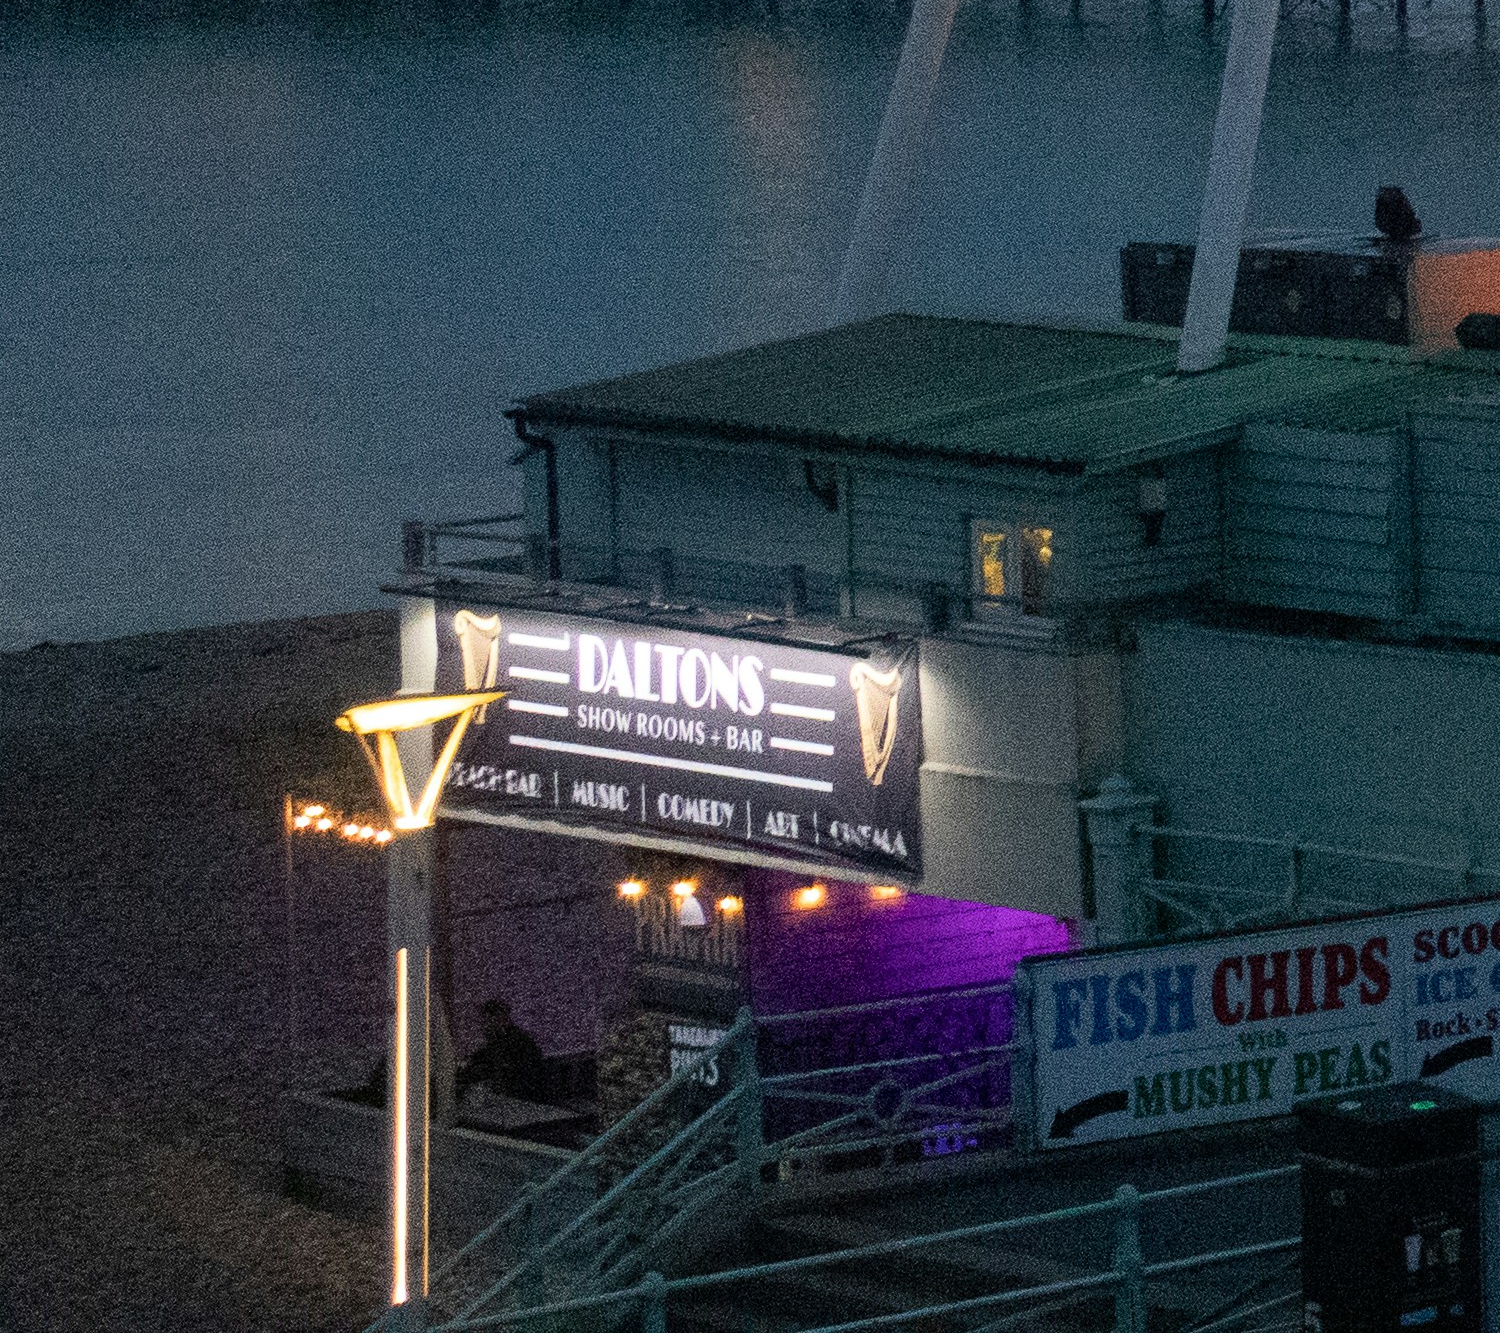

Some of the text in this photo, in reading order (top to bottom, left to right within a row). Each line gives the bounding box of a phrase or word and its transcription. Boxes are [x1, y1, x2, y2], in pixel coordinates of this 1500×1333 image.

[577, 632, 765, 716] DALTONS
[577, 704, 765, 754] SHOW ROOMS + BAR
[504, 766, 541, 799] BAR
[571, 778, 631, 813] MUSIC
[656, 791, 735, 829] COMEDY
[764, 810, 800, 840] ART
[1051, 935, 1392, 1050] FISH CHIPS
[1416, 965, 1475, 1008] ICE
[1238, 1027, 1289, 1052] With
[1416, 1014, 1471, 1044] Rock
[1132, 1039, 1392, 1120] MUSHY PEAS
